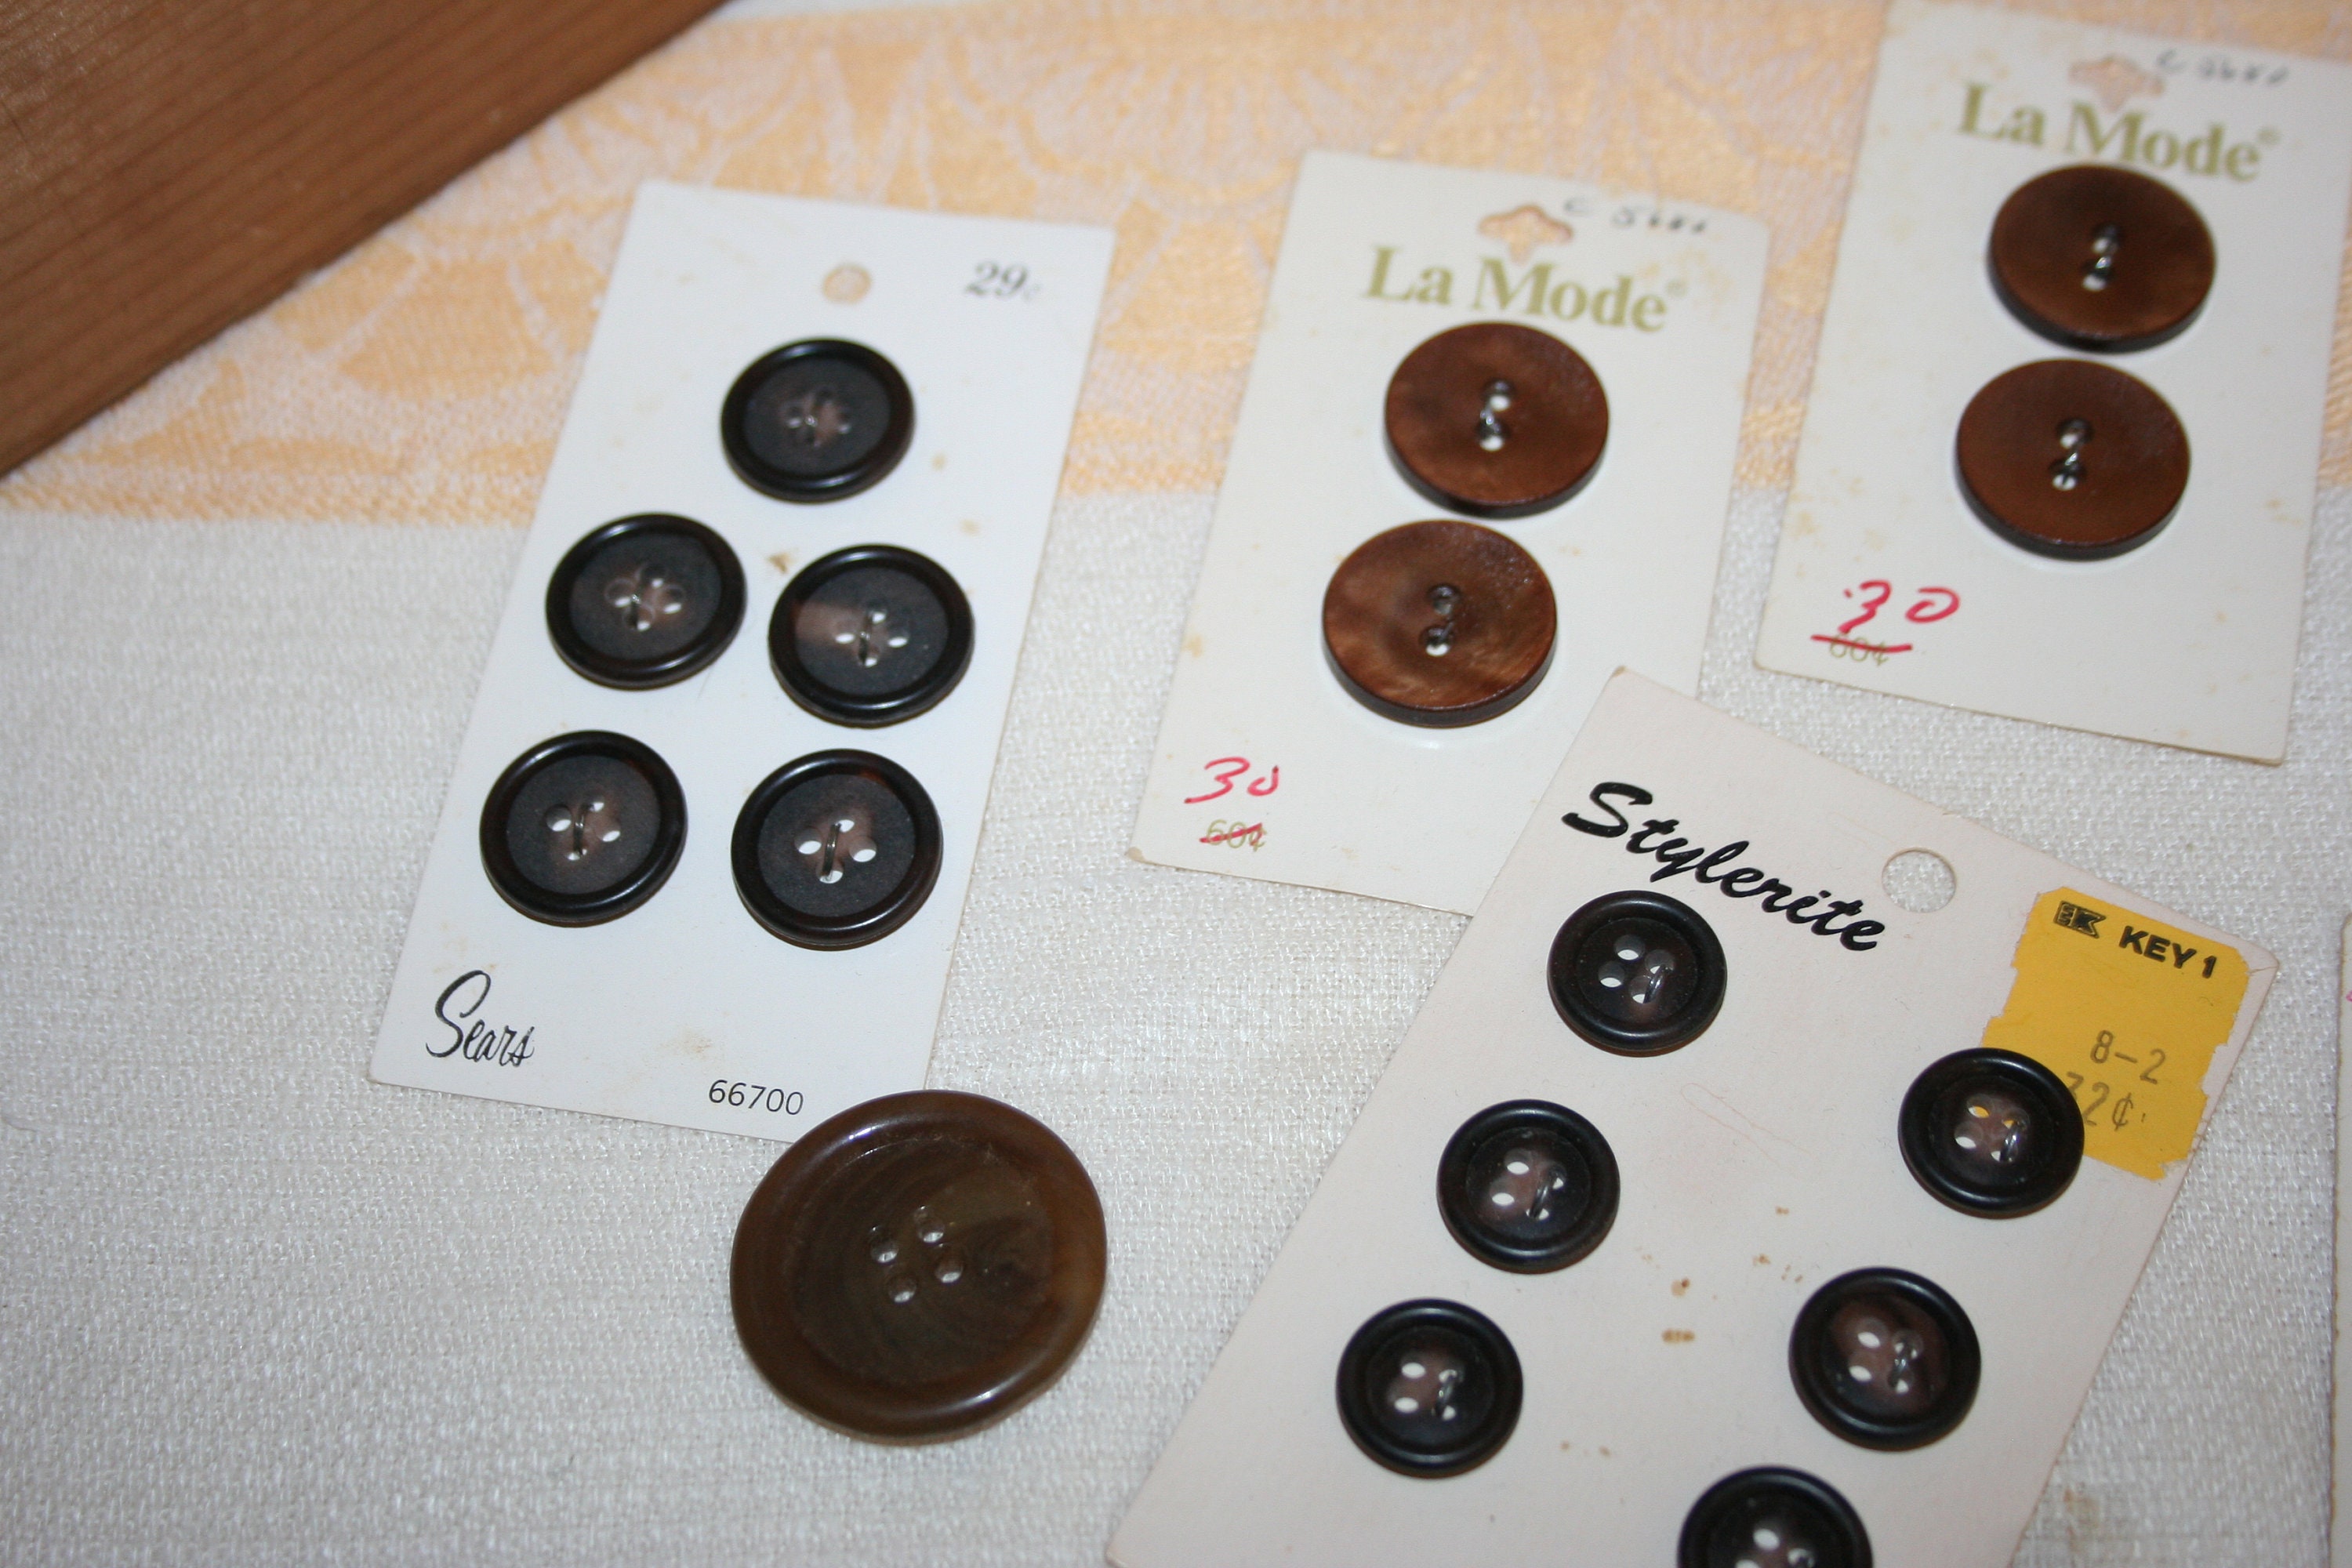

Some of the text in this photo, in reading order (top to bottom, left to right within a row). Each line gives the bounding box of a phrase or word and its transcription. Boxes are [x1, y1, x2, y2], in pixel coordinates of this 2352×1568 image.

[1958, 82, 2045, 149] La
[1362, 245, 1454, 307] La
[1561, 781, 1886, 952] Stylerite
[2118, 925, 2198, 969] KEY
[2201, 955, 2218, 979] 1
[425, 969, 535, 1068] Sears
[2089, 1029, 2167, 1085] 8-2
[708, 1079, 804, 1116] 66700
